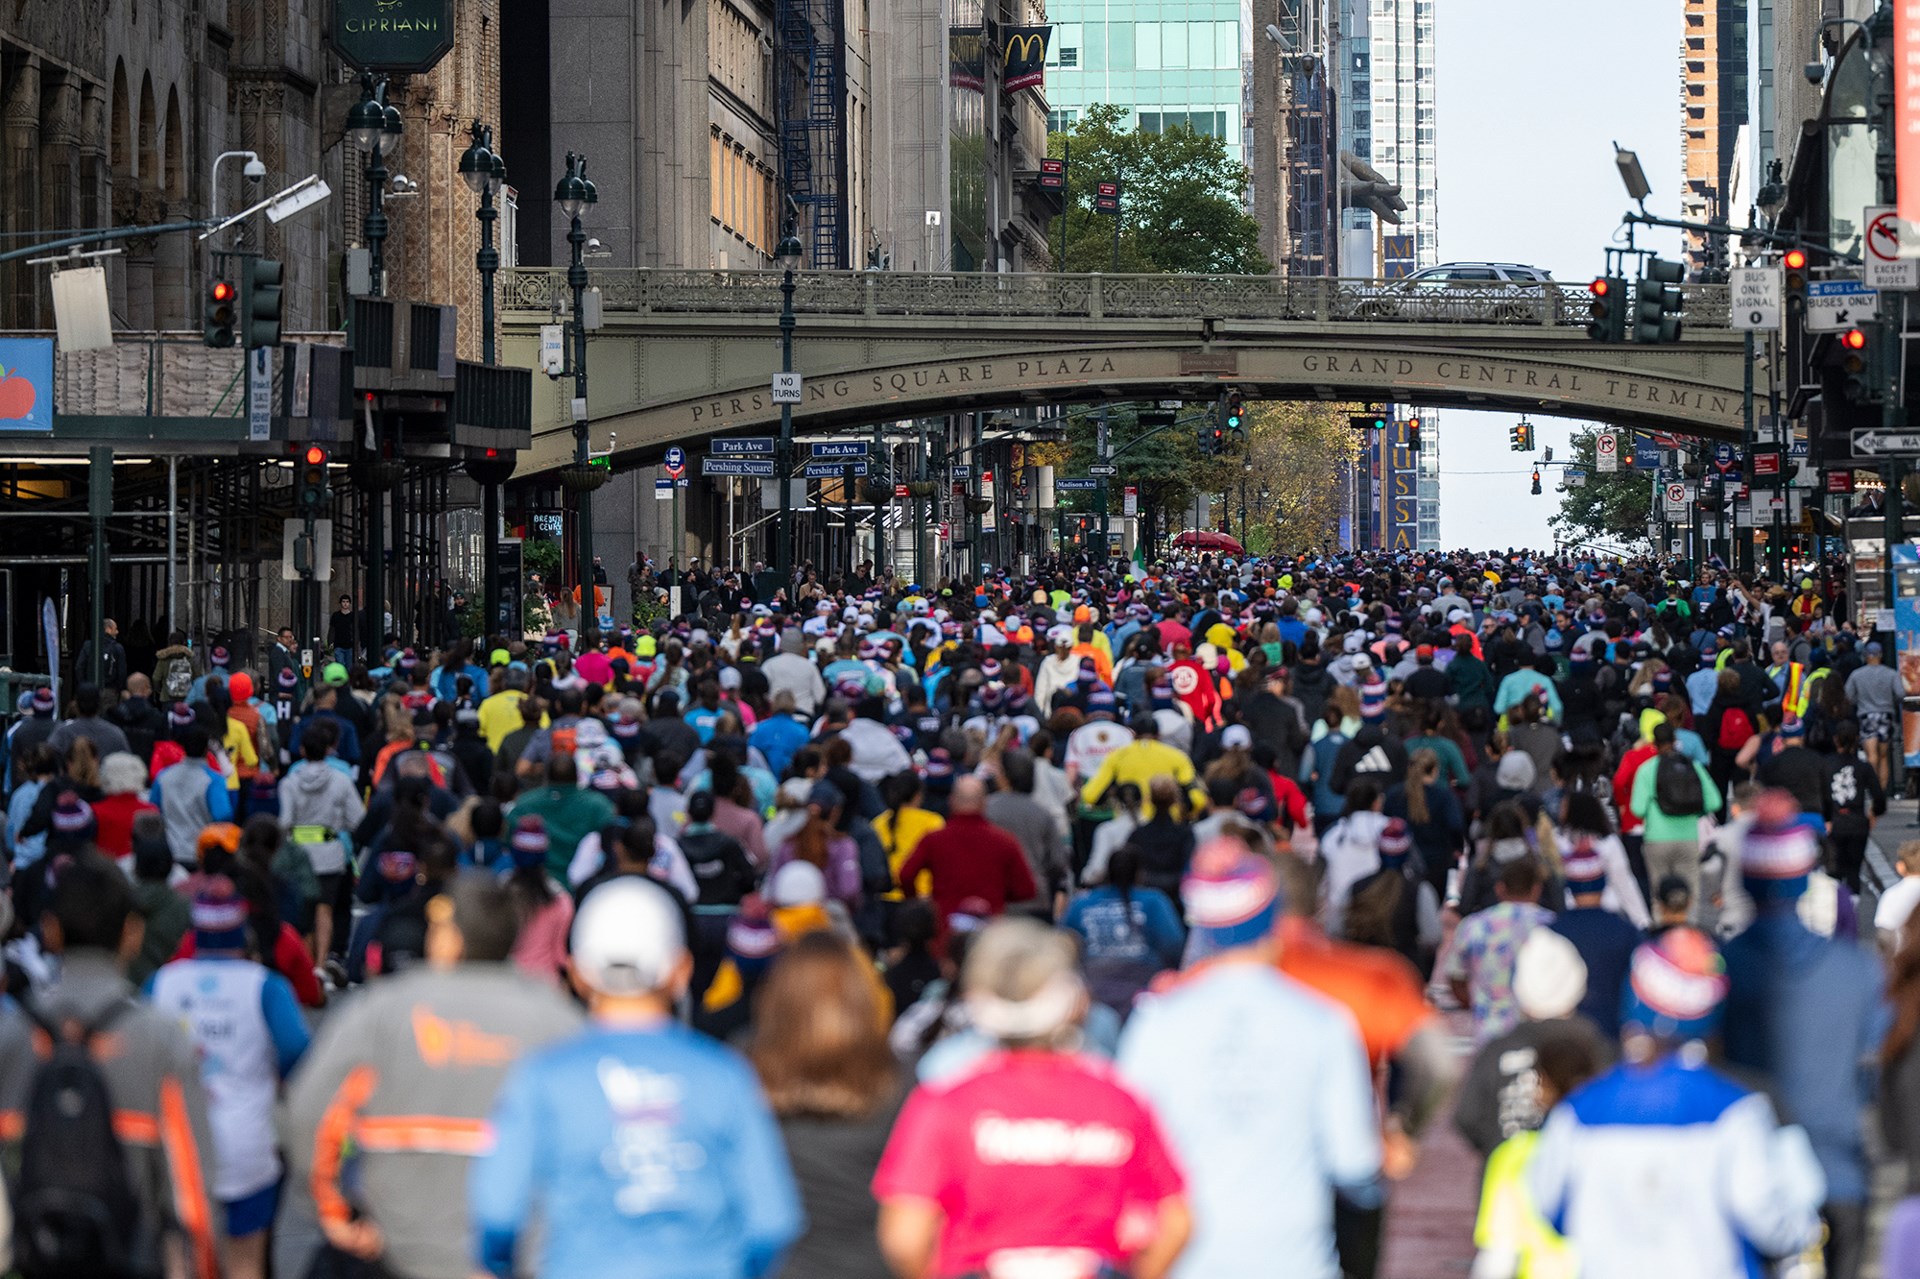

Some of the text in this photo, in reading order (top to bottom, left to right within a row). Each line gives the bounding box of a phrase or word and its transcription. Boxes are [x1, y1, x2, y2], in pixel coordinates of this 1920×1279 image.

[345, 18, 438, 32] CIPRIANI
[1873, 264, 1908, 274] EXCEPT
[1744, 271, 1767, 282] BUS
[1876, 275, 1907, 284] BUSES
[1740, 284, 1771, 295] ONLY
[1823, 284, 1844, 293] BUS
[1735, 297, 1776, 308] SIGNAL
[1808, 295, 1875, 308] BUSES ONLY
[872, 364, 993, 393] SQUARE
[1017, 357, 1116, 377] PLAZA
[1303, 355, 1414, 375] GRAND
[1437, 362, 1582, 391] CENTRAL
[780, 377, 794, 387] NO
[774, 389, 801, 398] TURNS
[722, 441, 764, 451] Park Ave
[1863, 436, 1886, 448] ONE
[821, 445, 858, 454] Park Ave
[705, 462, 773, 475] Pershing Square
[953, 468, 968, 477] Ave
[277, 700, 291, 720] H
